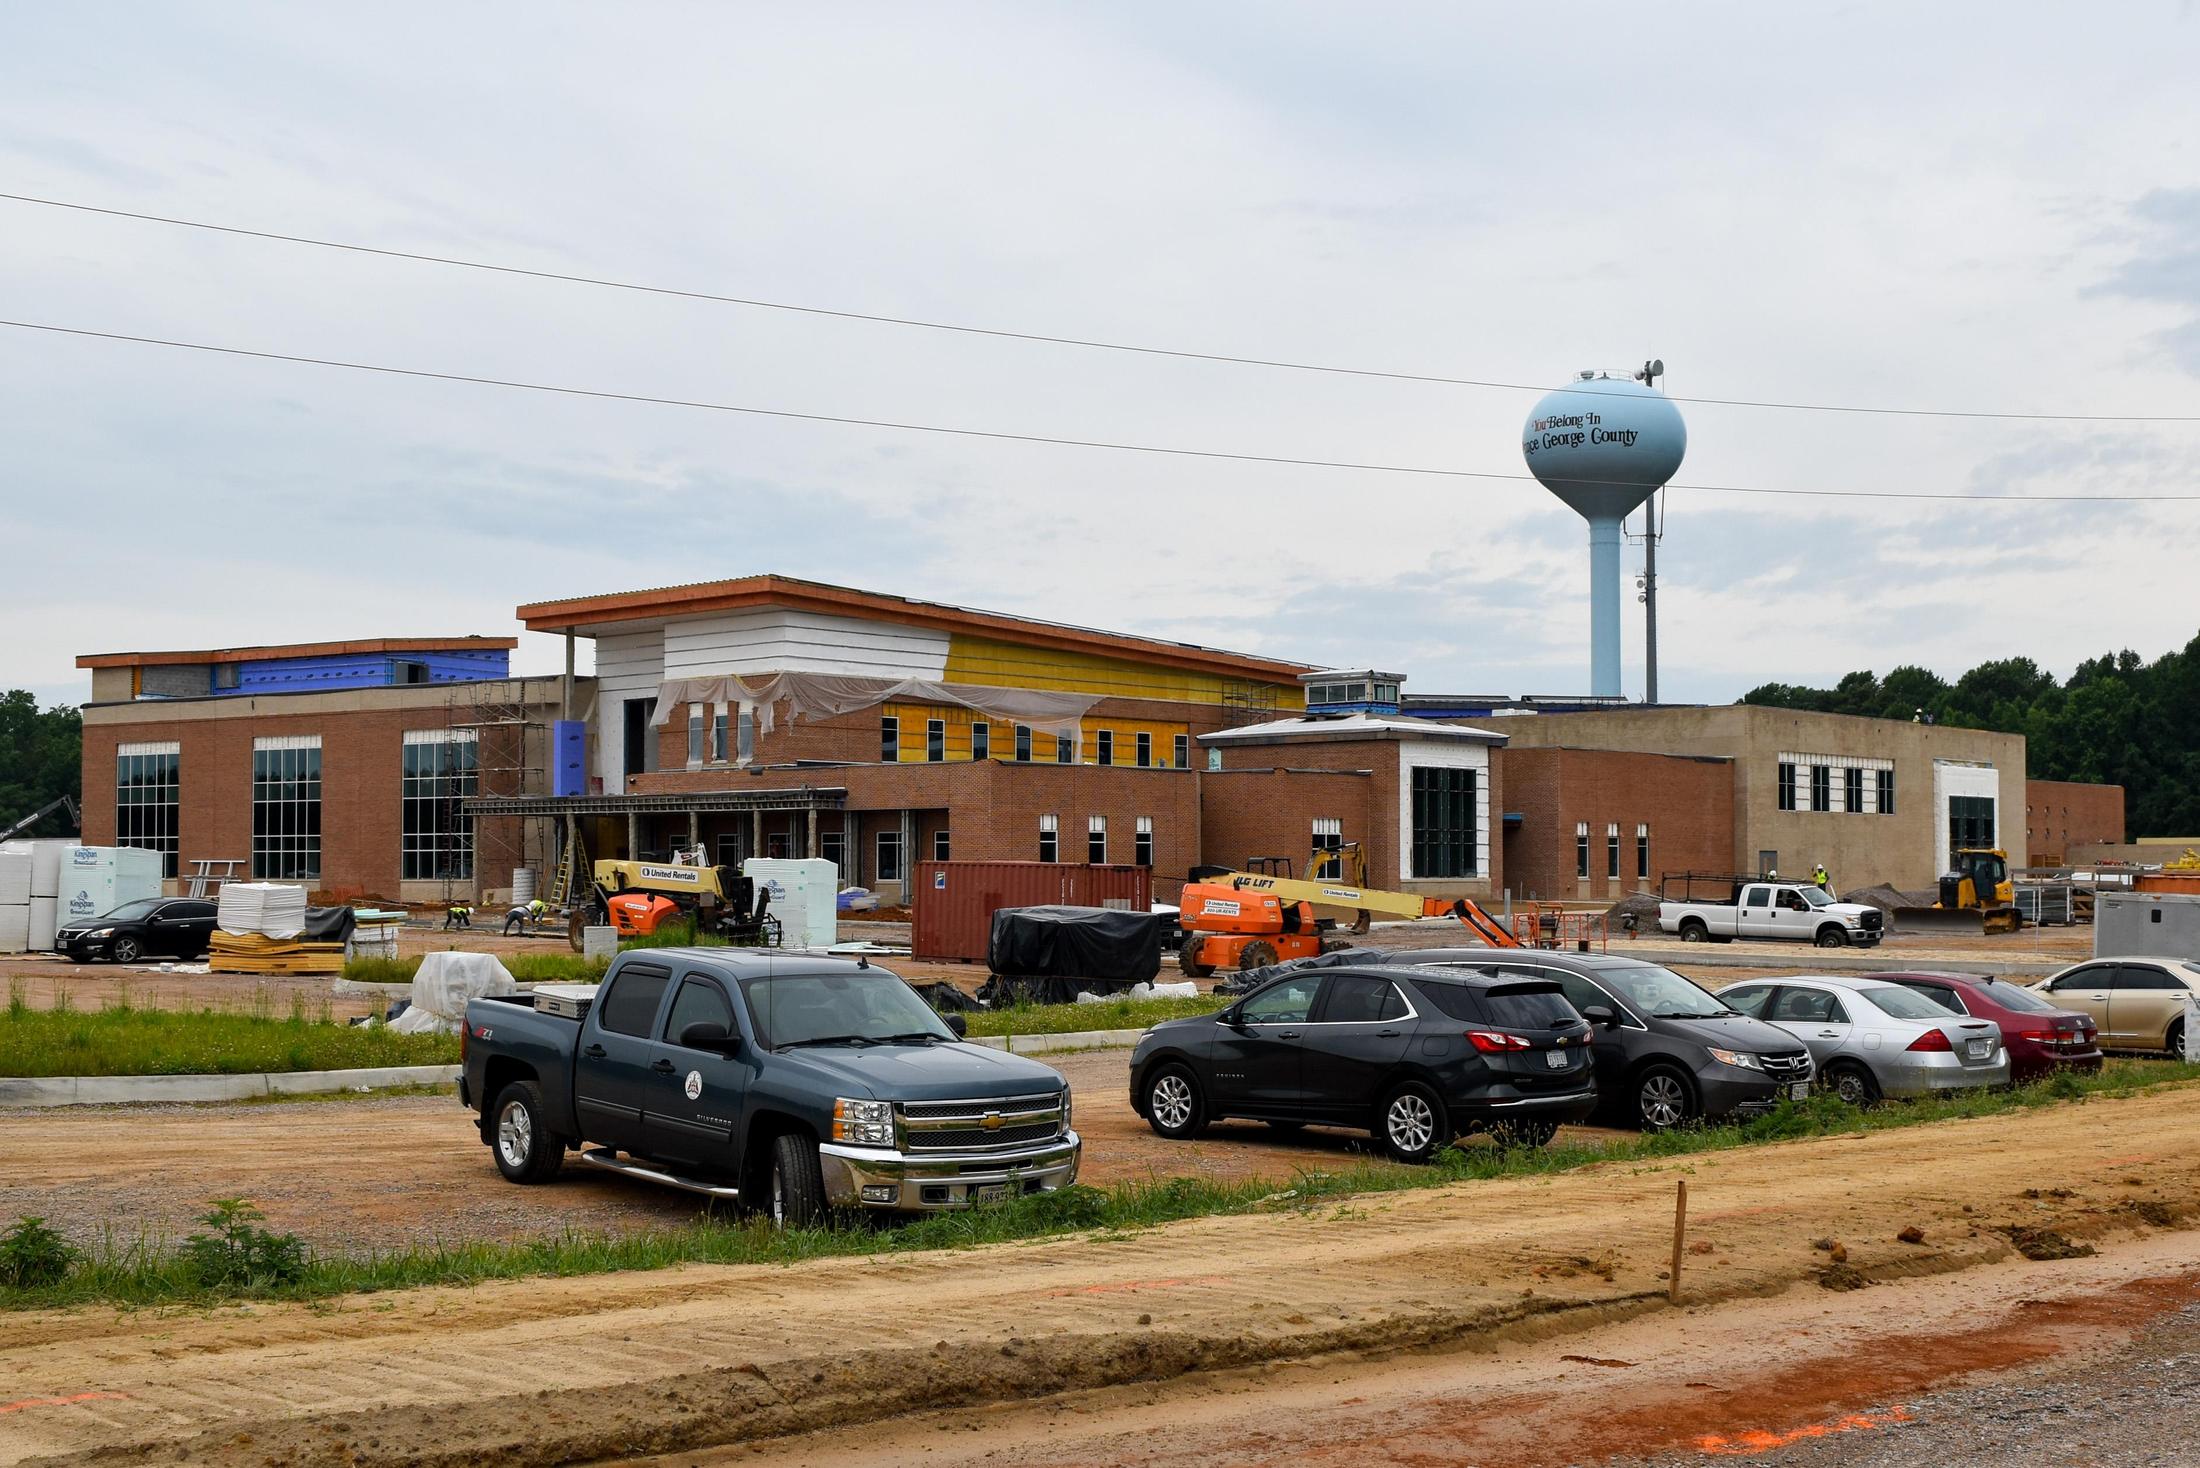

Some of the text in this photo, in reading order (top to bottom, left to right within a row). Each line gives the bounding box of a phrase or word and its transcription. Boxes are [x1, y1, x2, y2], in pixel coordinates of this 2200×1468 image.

[1547, 414, 1583, 429] Belong
[1586, 412, 1601, 425] In
[1542, 432, 1585, 449] George
[1591, 427, 1639, 447] County
[651, 869, 696, 881] United Rentals
[1253, 878, 1275, 889] LIFT
[70, 900, 95, 909] Kingspan
